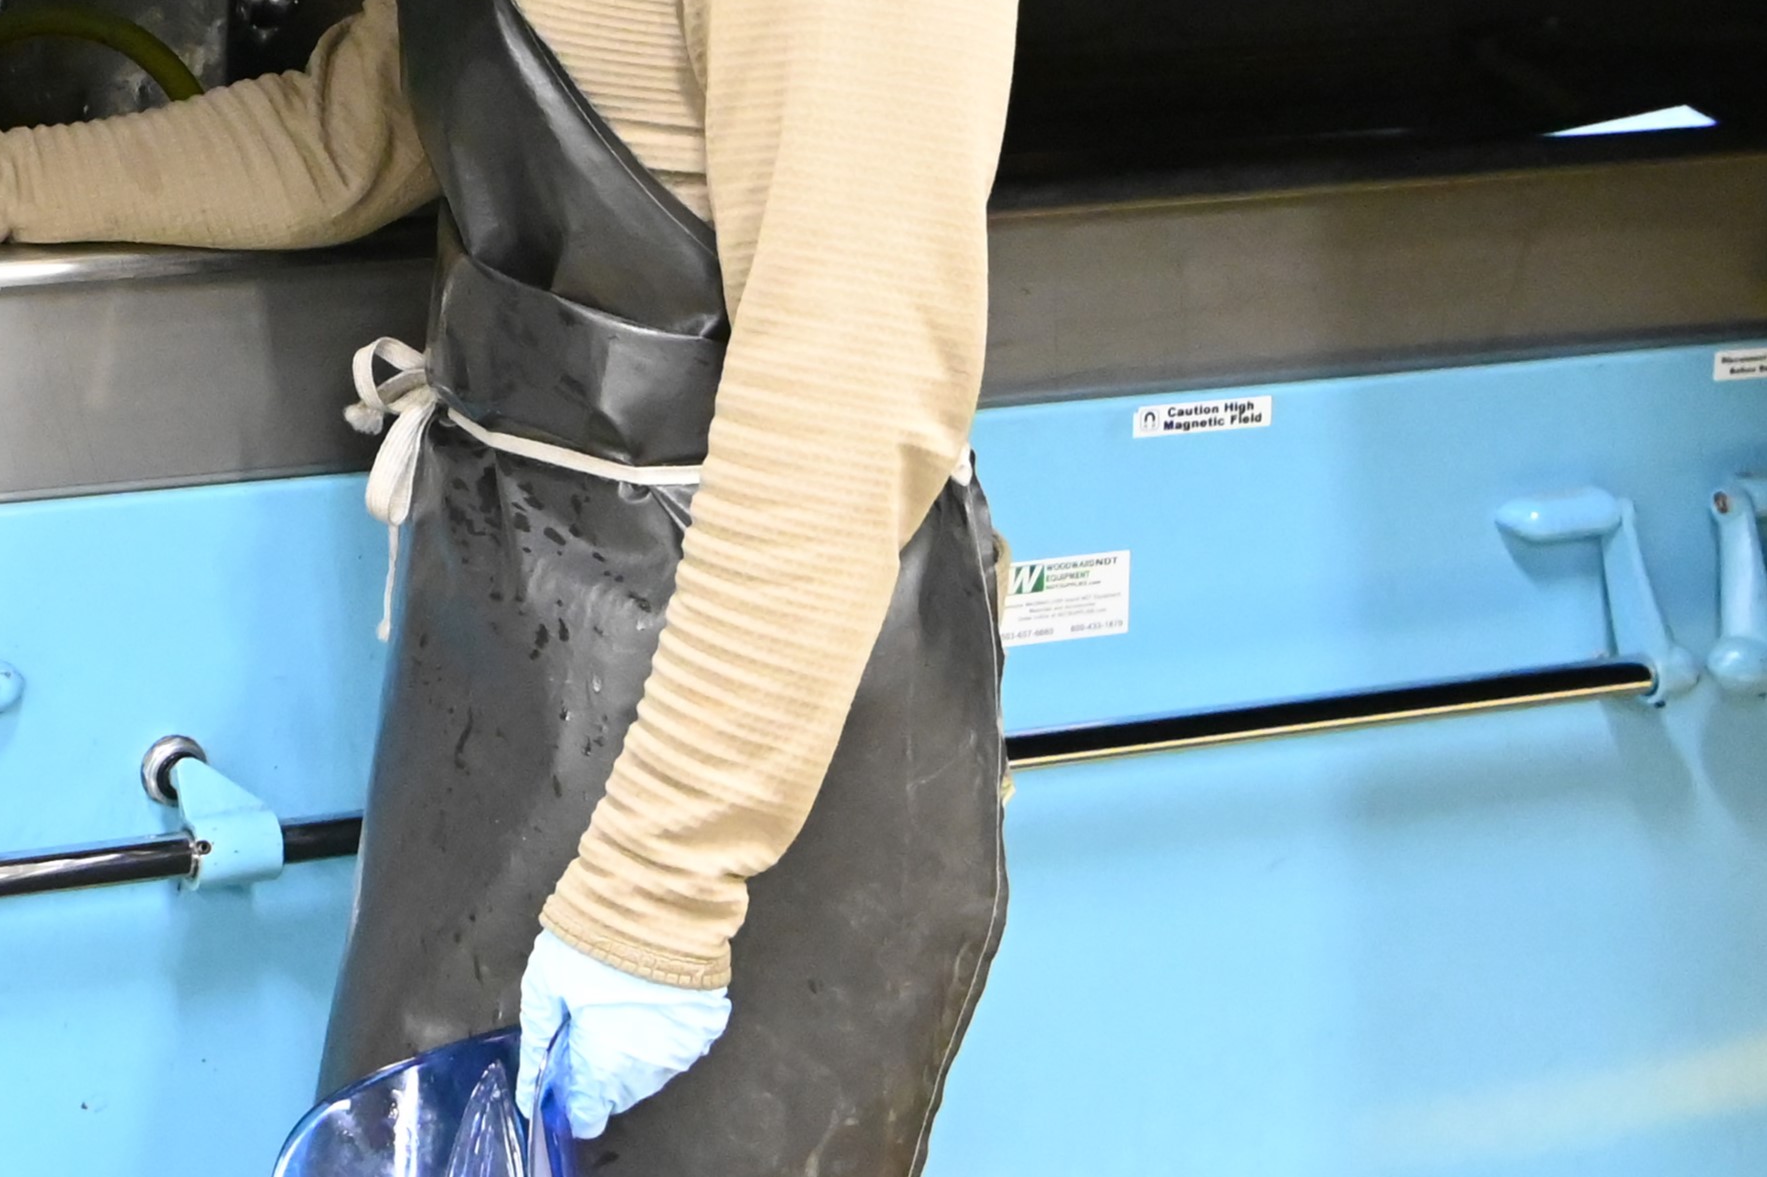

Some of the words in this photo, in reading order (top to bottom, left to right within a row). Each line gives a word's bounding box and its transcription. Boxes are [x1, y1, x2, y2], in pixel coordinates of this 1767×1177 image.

[1167, 406, 1220, 418] Caution
[1224, 400, 1255, 415] High
[1163, 416, 1225, 432] Magnetic
[1230, 412, 1263, 425] Field
